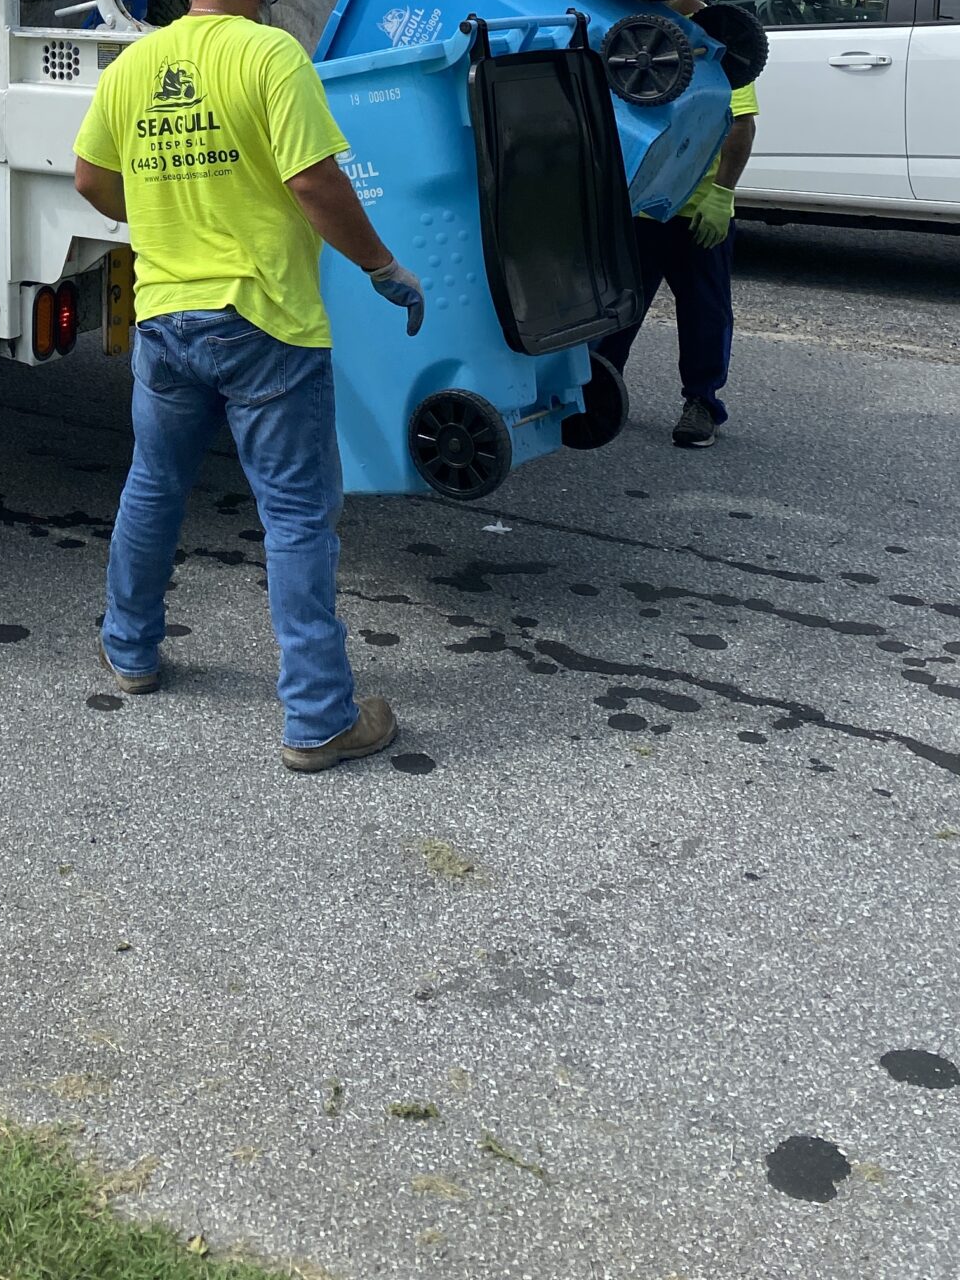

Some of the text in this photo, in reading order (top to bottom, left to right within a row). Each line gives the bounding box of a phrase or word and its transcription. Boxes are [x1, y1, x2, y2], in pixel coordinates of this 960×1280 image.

[350, 87, 401, 106] 19 000169
[136, 111, 221, 138] SEAGULL
[150, 137, 206, 152] DISPSL
[131, 156, 167, 174] (443)
